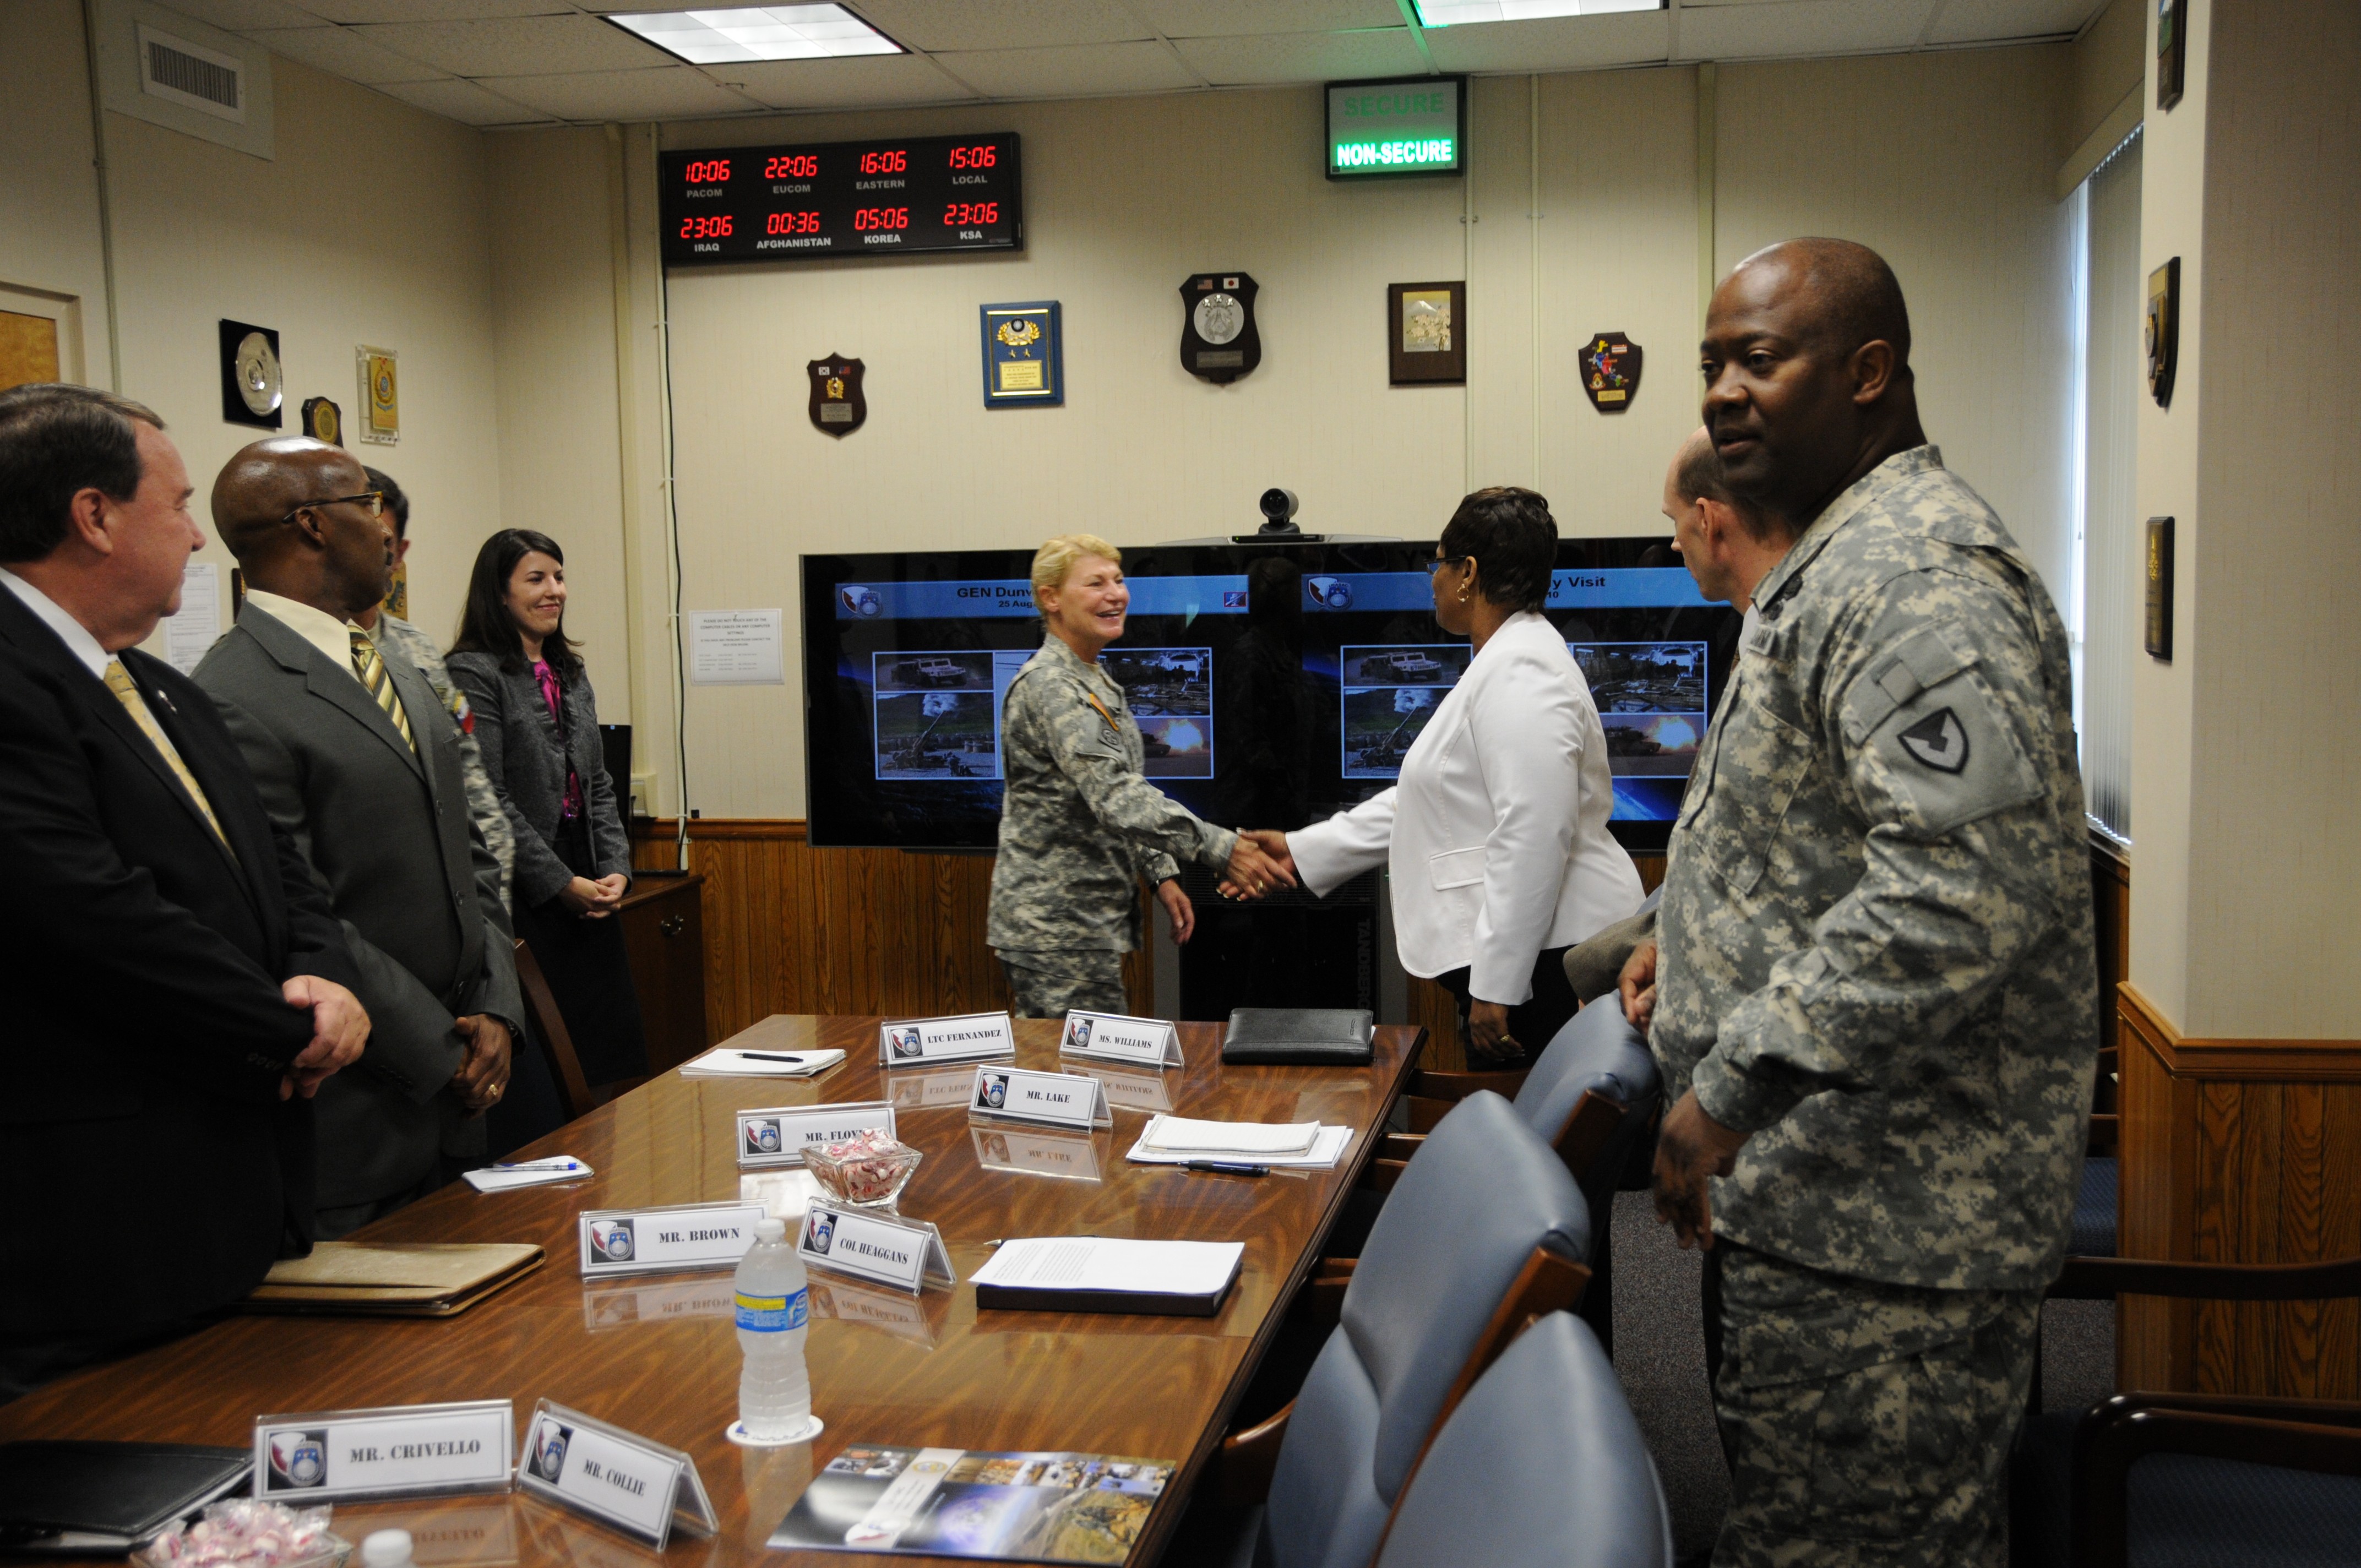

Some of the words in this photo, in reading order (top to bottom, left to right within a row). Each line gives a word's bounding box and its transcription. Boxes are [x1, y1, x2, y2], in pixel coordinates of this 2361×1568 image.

[1344, 92, 1444, 117] SECURE
[949, 146, 995, 168] 15:06
[1337, 139, 1452, 166] NON-SECURE
[765, 156, 817, 178] 22:06
[860, 151, 906, 173] 16:06
[686, 160, 730, 183] 10:06
[856, 180, 905, 189] EASTERN
[953, 175, 987, 185] LOCAL
[687, 188, 723, 198] PACOM
[773, 184, 810, 194] EUCOM
[855, 208, 908, 230] 05:06
[944, 203, 998, 225] 23:06
[681, 216, 732, 238] 23:06
[767, 212, 820, 234] 00:36
[757, 237, 831, 249] AFGHANISTAN
[864, 235, 901, 244] KOREA
[960, 231, 982, 240] KSA
[694, 243, 720, 253] IRAQ
[1568, 576, 1606, 587] Visit
[957, 587, 991, 598] GEN
[1012, 600, 1033, 609] Aug
[928, 1036, 945, 1044] LTC
[947, 1029, 1002, 1042] FERNANDEZ
[1100, 1034, 1112, 1043] MS.
[1114, 1036, 1152, 1049] WILLIAMS
[1026, 1090, 1043, 1101] MR.
[1046, 1092, 1070, 1103] LAKE
[805, 1132, 826, 1142] MR.
[659, 1231, 685, 1243] MR.
[689, 1228, 741, 1242] BROWN
[840, 1238, 857, 1251] COL
[859, 1242, 909, 1265] HEAGGANS
[350, 1447, 385, 1463] MR.
[390, 1439, 481, 1460] CRIVELLO
[584, 1458, 602, 1479] MR.
[606, 1468, 646, 1497] COLLIE
